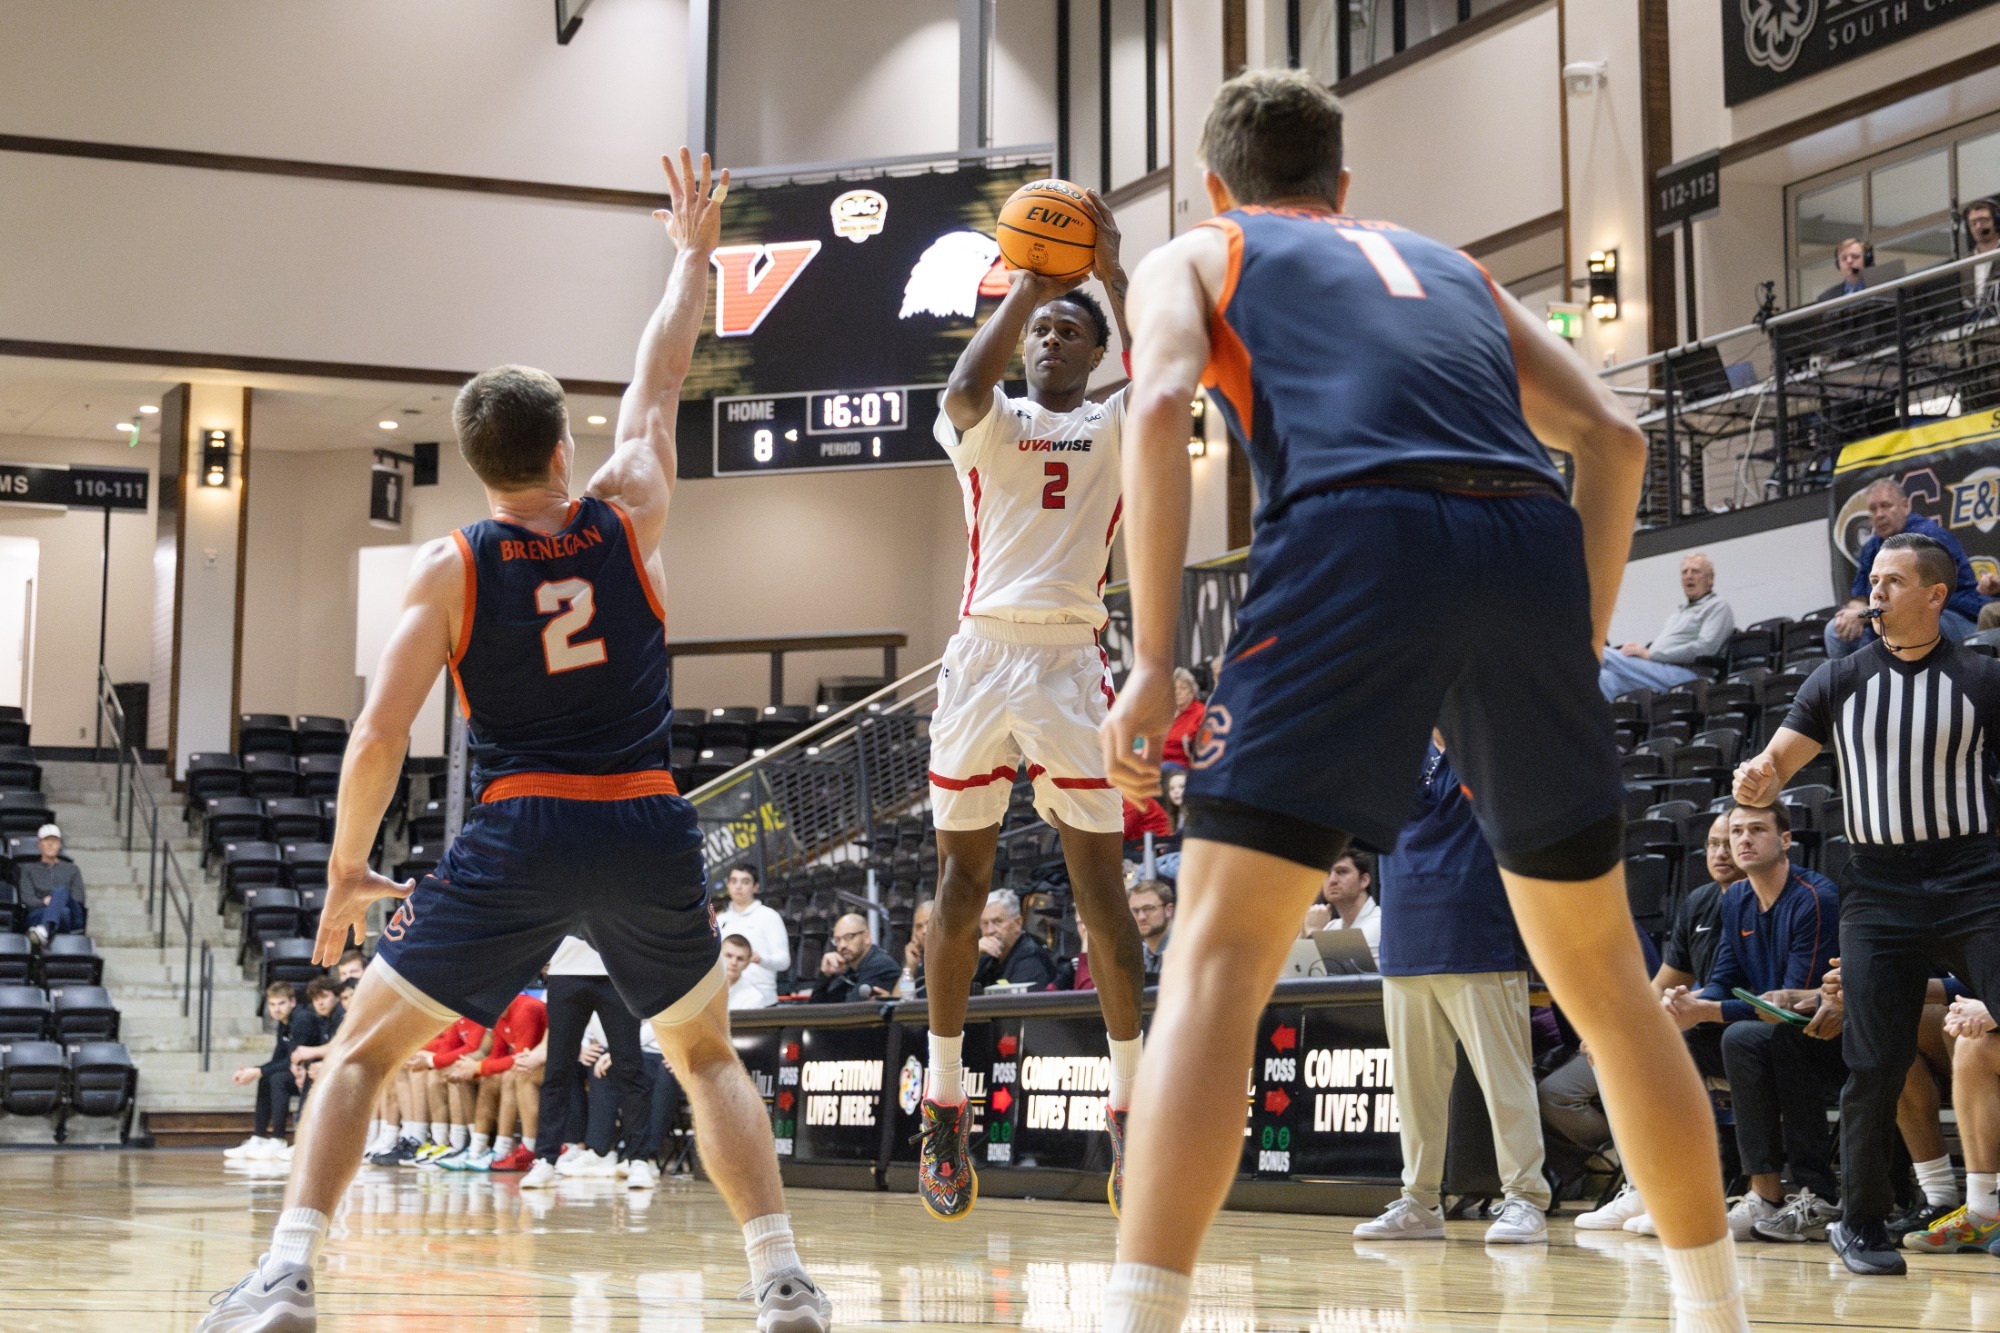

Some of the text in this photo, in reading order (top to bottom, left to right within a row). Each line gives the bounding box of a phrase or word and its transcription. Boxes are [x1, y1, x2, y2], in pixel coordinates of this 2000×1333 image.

[1828, 2, 1909, 50] SOUTH
[1024, 182, 1083, 200] Wilso
[1661, 172, 1716, 211] 112-113
[1026, 206, 1074, 229] EVO
[1335, 227, 1427, 299] 1
[727, 401, 775, 423] HOME
[823, 391, 900, 428] 16:07
[754, 429, 773, 462] 8
[820, 442, 862, 458] PERIOD
[73, 479, 144, 499] 110-111
[1042, 462, 1069, 509] 2
[1953, 478, 2000, 525] E&
[500, 525, 603, 561] BRENEGAN
[534, 576, 608, 675] 2
[778, 1066, 799, 1086] POSS
[801, 1060, 884, 1091] COMPETITION
[992, 1062, 1017, 1083] POSS
[1021, 1056, 1111, 1091] COMPETITIO
[1264, 1058, 1296, 1082] POSS
[1304, 1048, 1393, 1088] COMPETI
[806, 1095, 839, 1126] LIVES
[1026, 1095, 1067, 1129] LIVES
[1314, 1093, 1400, 1132] LIVES HE
[774, 1138, 793, 1155] ONUS
[987, 1143, 1011, 1161] BONUS
[1258, 1150, 1290, 1172] BONUS
